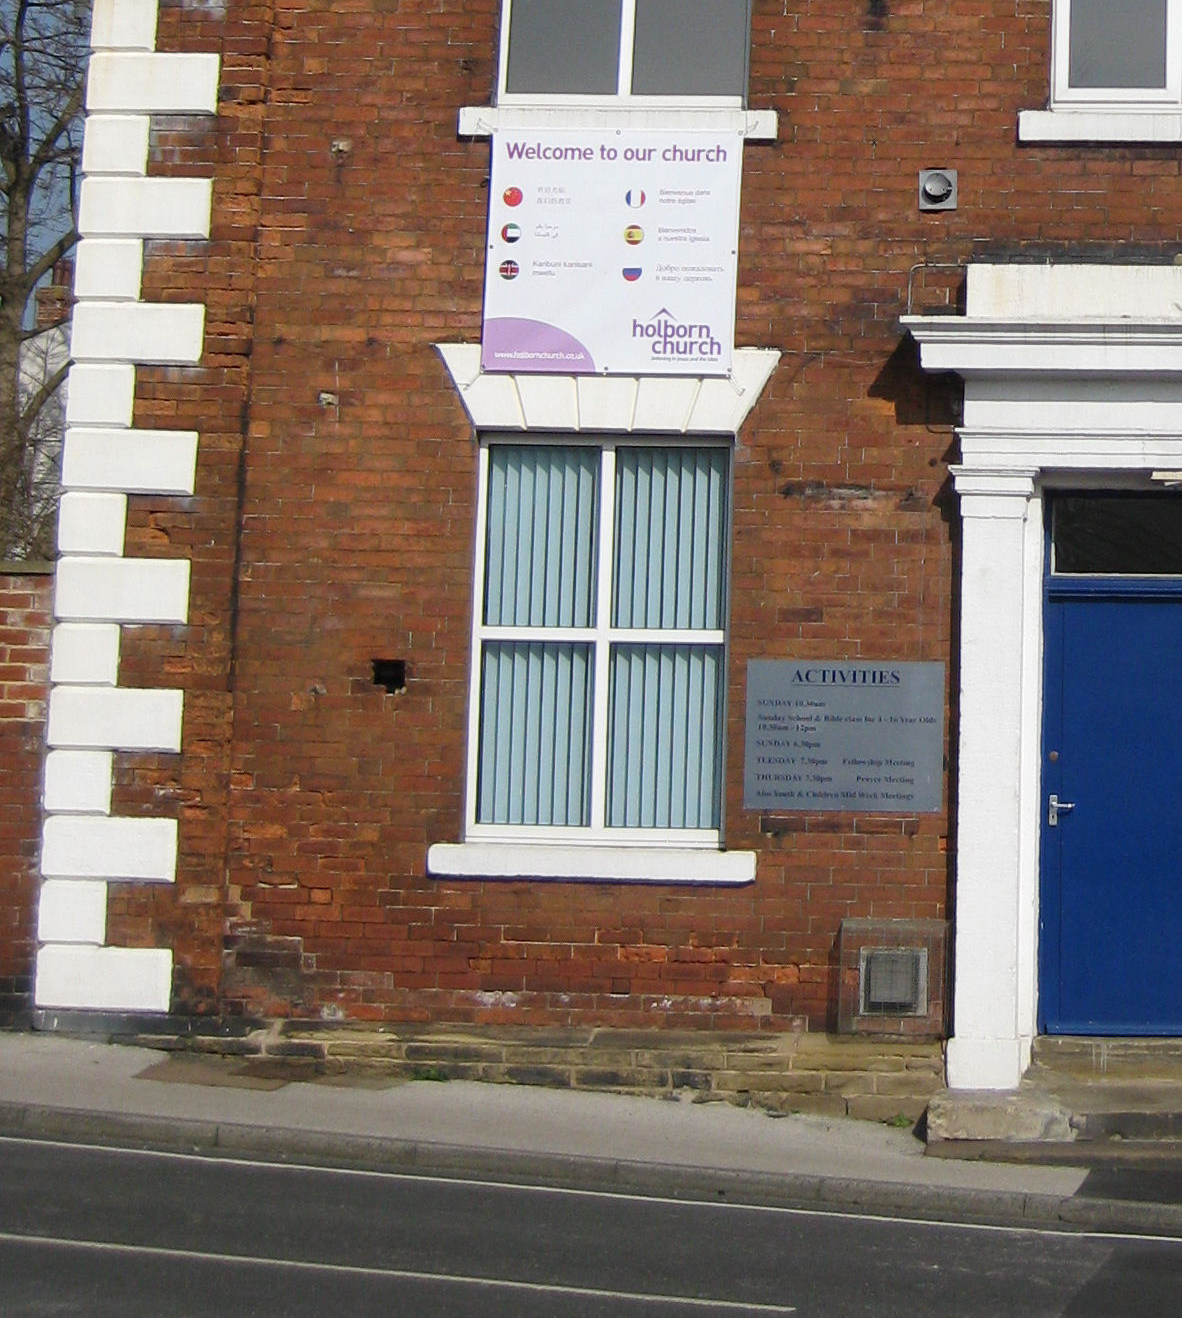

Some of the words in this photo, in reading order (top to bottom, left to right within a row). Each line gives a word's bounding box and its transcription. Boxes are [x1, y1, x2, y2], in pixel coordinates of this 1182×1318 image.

[506, 142, 594, 160] Welcome
[600, 144, 618, 161] to
[623, 146, 657, 162] our
[662, 144, 727, 162] church
[632, 318, 711, 339] holborn
[652, 337, 722, 355] church
[791, 669, 900, 684] ACTIVITIES
